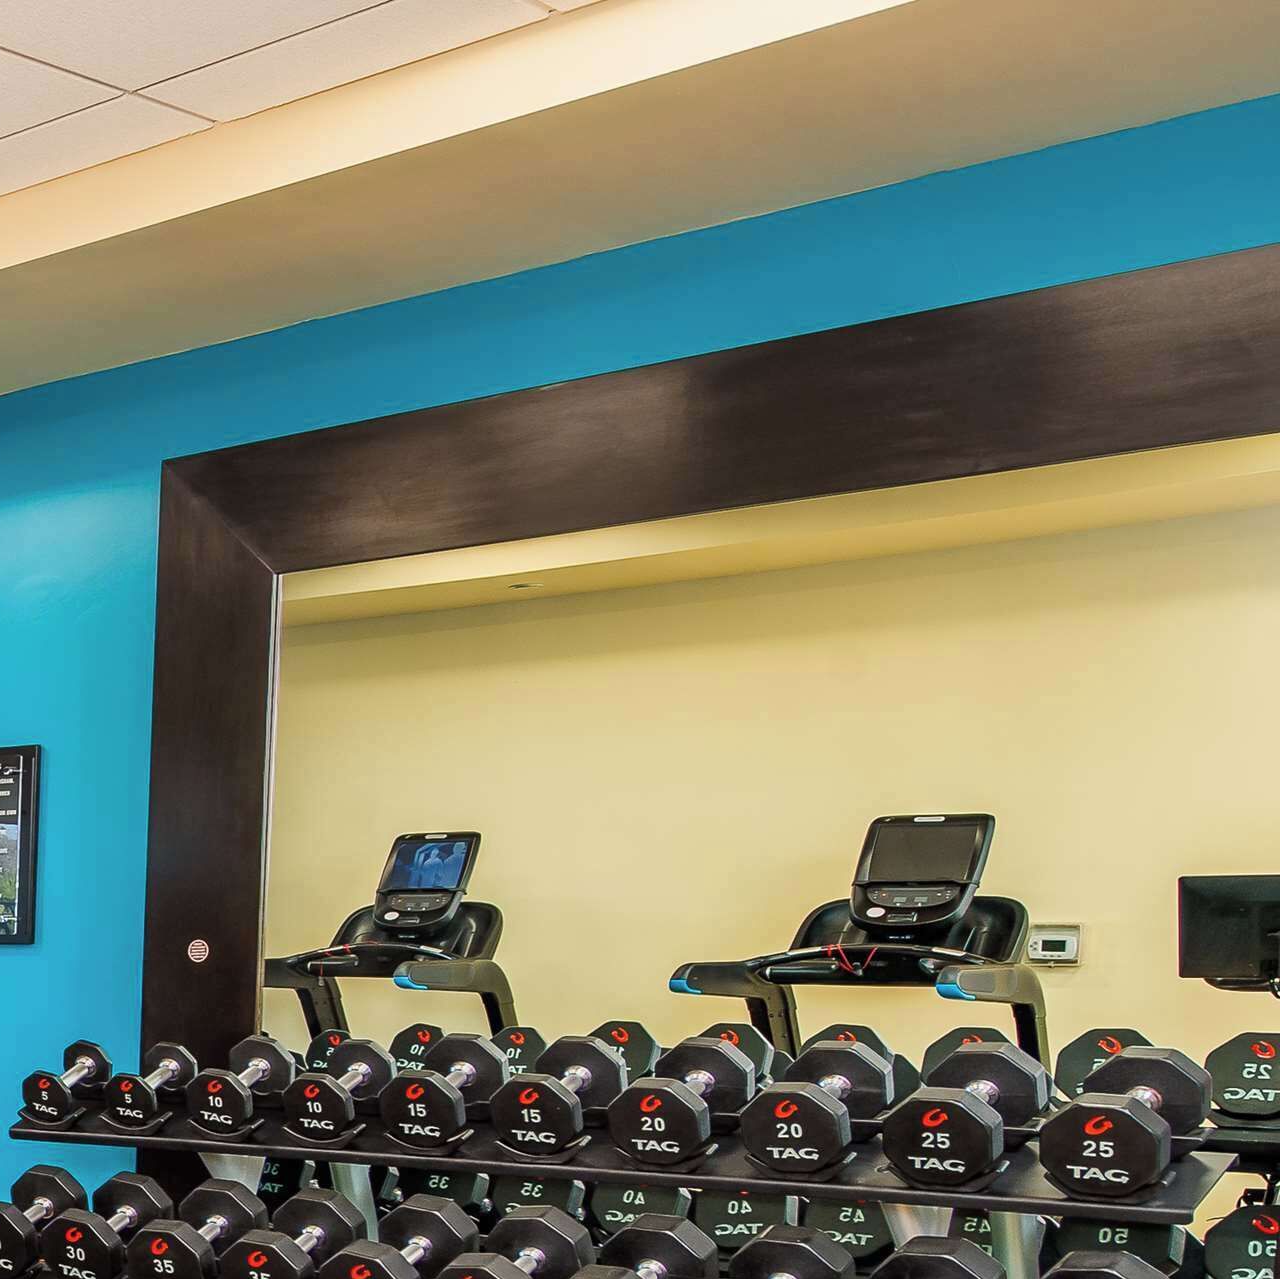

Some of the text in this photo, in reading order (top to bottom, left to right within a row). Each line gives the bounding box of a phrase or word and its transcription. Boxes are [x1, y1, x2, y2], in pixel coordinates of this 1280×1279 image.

[41, 1092, 48, 1101] 5
[124, 1093, 132, 1103] 5
[207, 1095, 223, 1108] 10
[33, 1102, 57, 1115] TAG
[116, 1106, 143, 1119] TAG
[307, 1100, 322, 1113] 10
[408, 1102, 427, 1118] 15
[200, 1110, 233, 1125] TAG
[521, 1108, 541, 1123] 15
[299, 1118, 334, 1131] TAG
[399, 1122, 440, 1137] TAG
[640, 1116, 665, 1132] 20
[776, 1122, 802, 1138] 20
[511, 1129, 556, 1145] TAG
[921, 1132, 950, 1149] 25
[631, 1138, 680, 1154] TAG
[766, 1146, 819, 1161] TAG
[1082, 1140, 1114, 1158] 25
[908, 1157, 965, 1173] TAG
[1067, 1166, 1129, 1183] TAG
[66, 1247, 85, 1261] 30
[154, 1259, 174, 1273] 35
